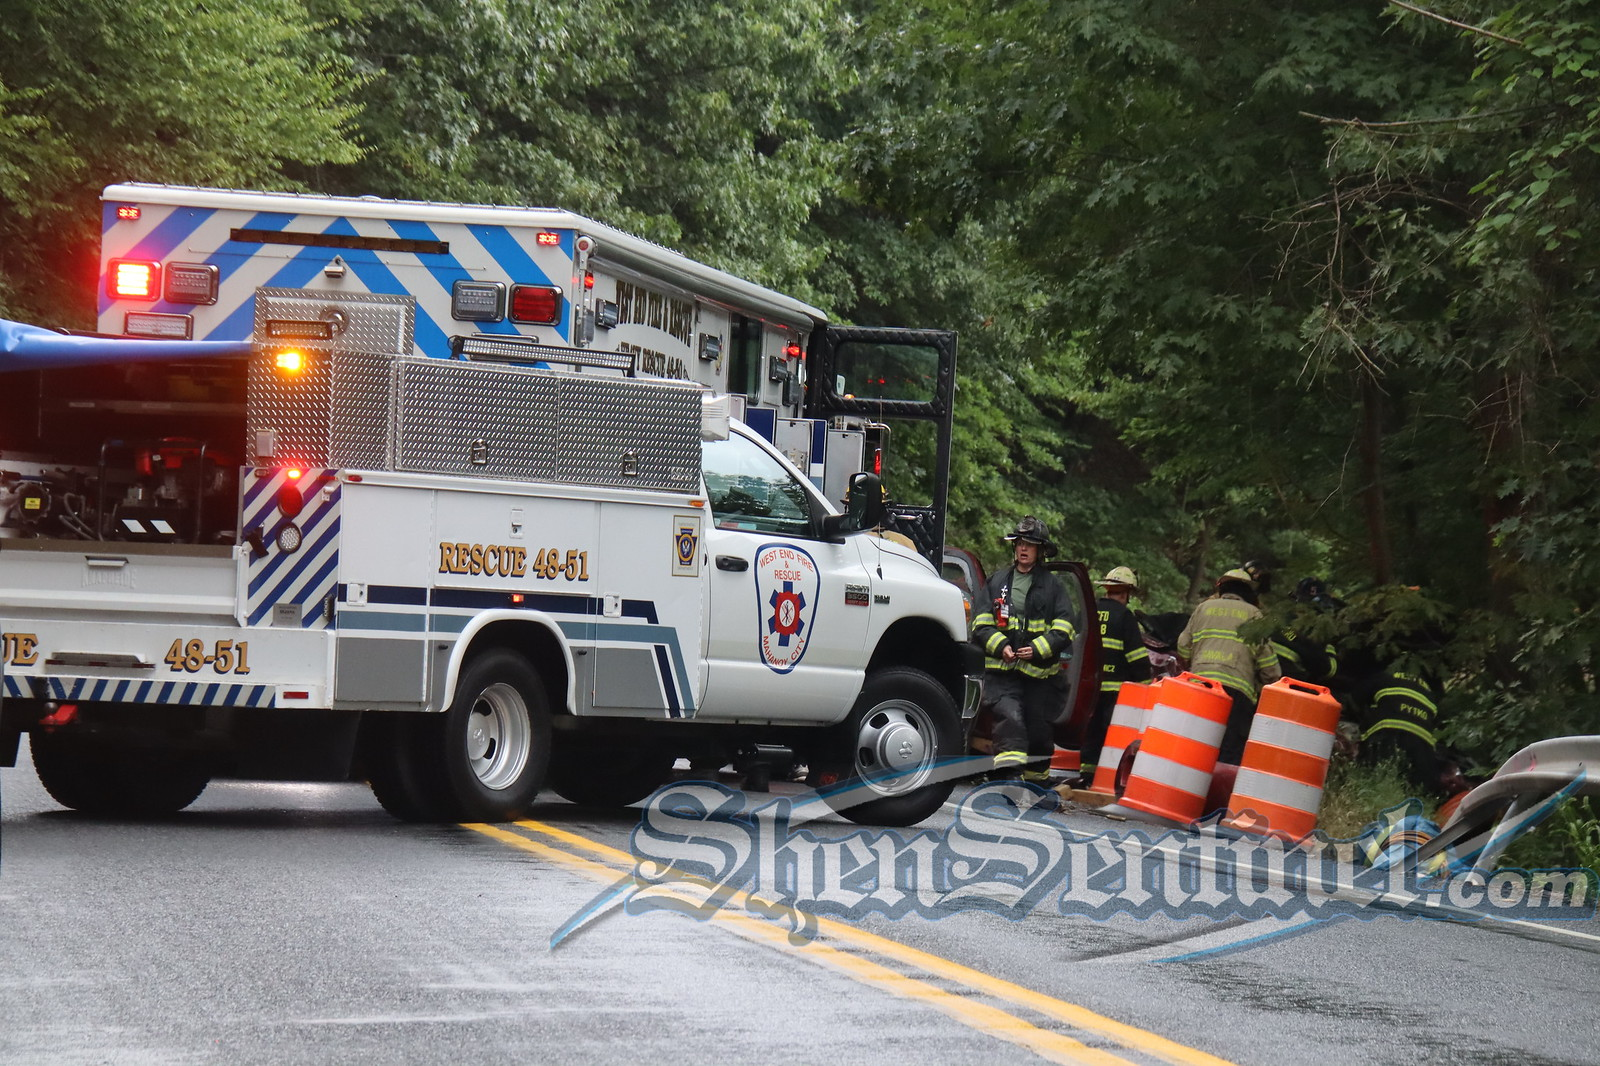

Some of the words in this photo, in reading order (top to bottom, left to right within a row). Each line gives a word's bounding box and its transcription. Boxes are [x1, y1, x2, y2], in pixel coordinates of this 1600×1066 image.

[439, 541, 527, 577] RESCUE
[533, 548, 589, 581] 48-51
[759, 549, 777, 568] WEST
[780, 549, 795, 560] END
[796, 554, 814, 573] FIRE
[784, 560, 789, 569] &
[774, 570, 801, 581] RESCUE
[164, 638, 250, 675] 48-51
[763, 635, 788, 666] MAHANOY
[791, 637, 805, 661] CITY
